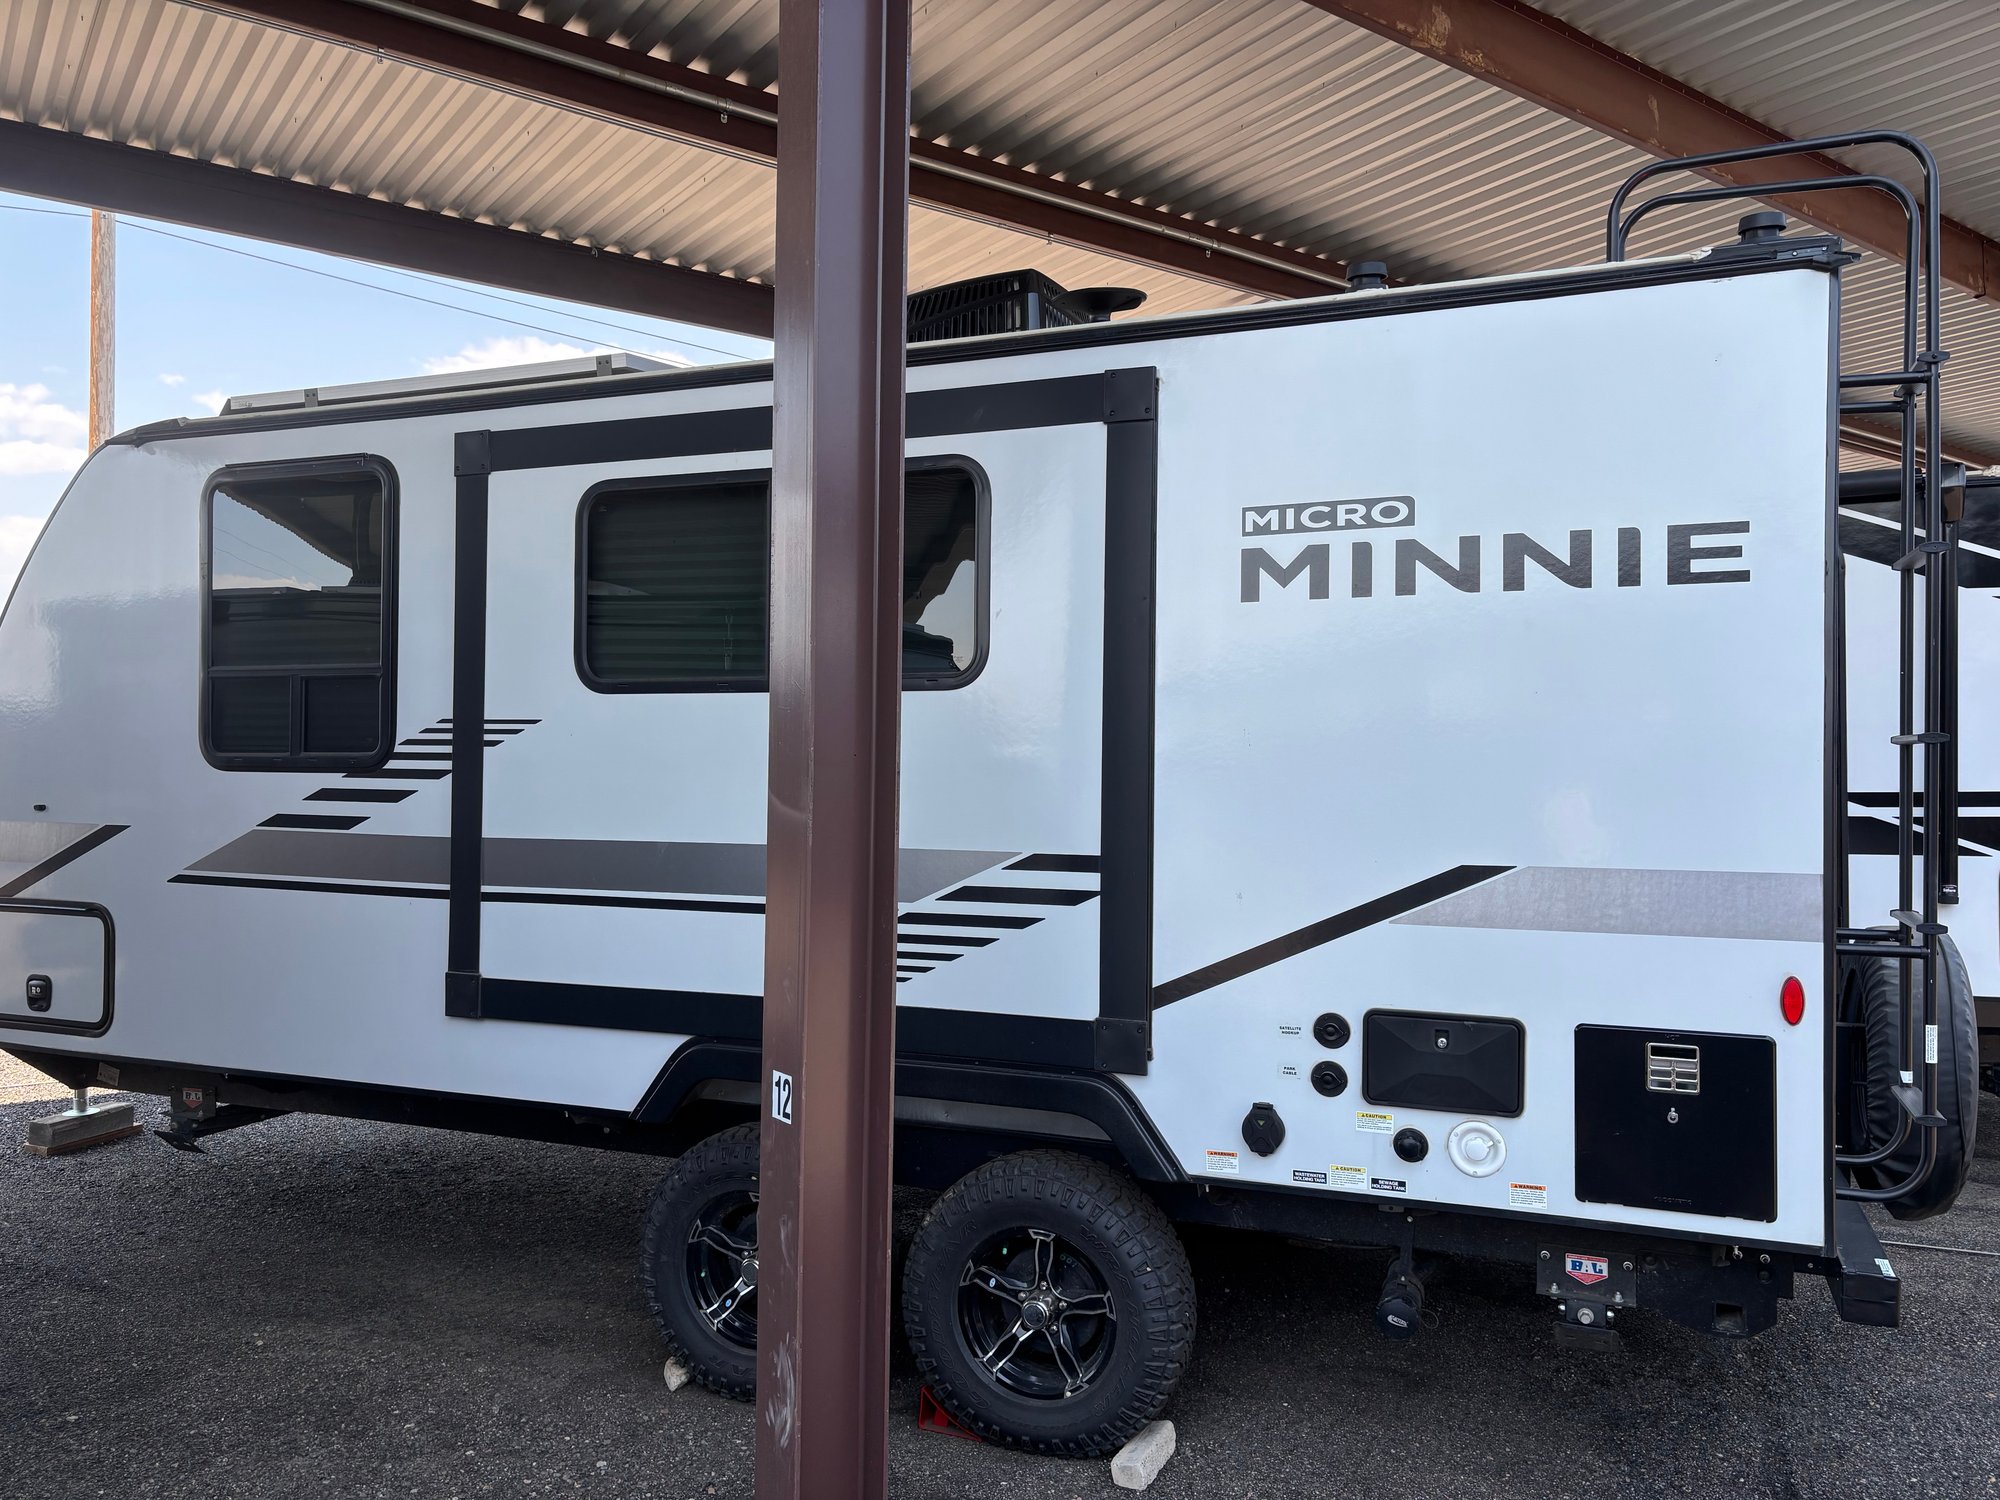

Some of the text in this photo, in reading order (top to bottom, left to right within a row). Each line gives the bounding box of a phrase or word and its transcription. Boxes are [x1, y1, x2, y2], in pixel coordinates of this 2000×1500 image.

[1245, 500, 1409, 533] MICRO
[1241, 520, 1751, 603] MINNIE
[774, 1075, 791, 1121] 12
